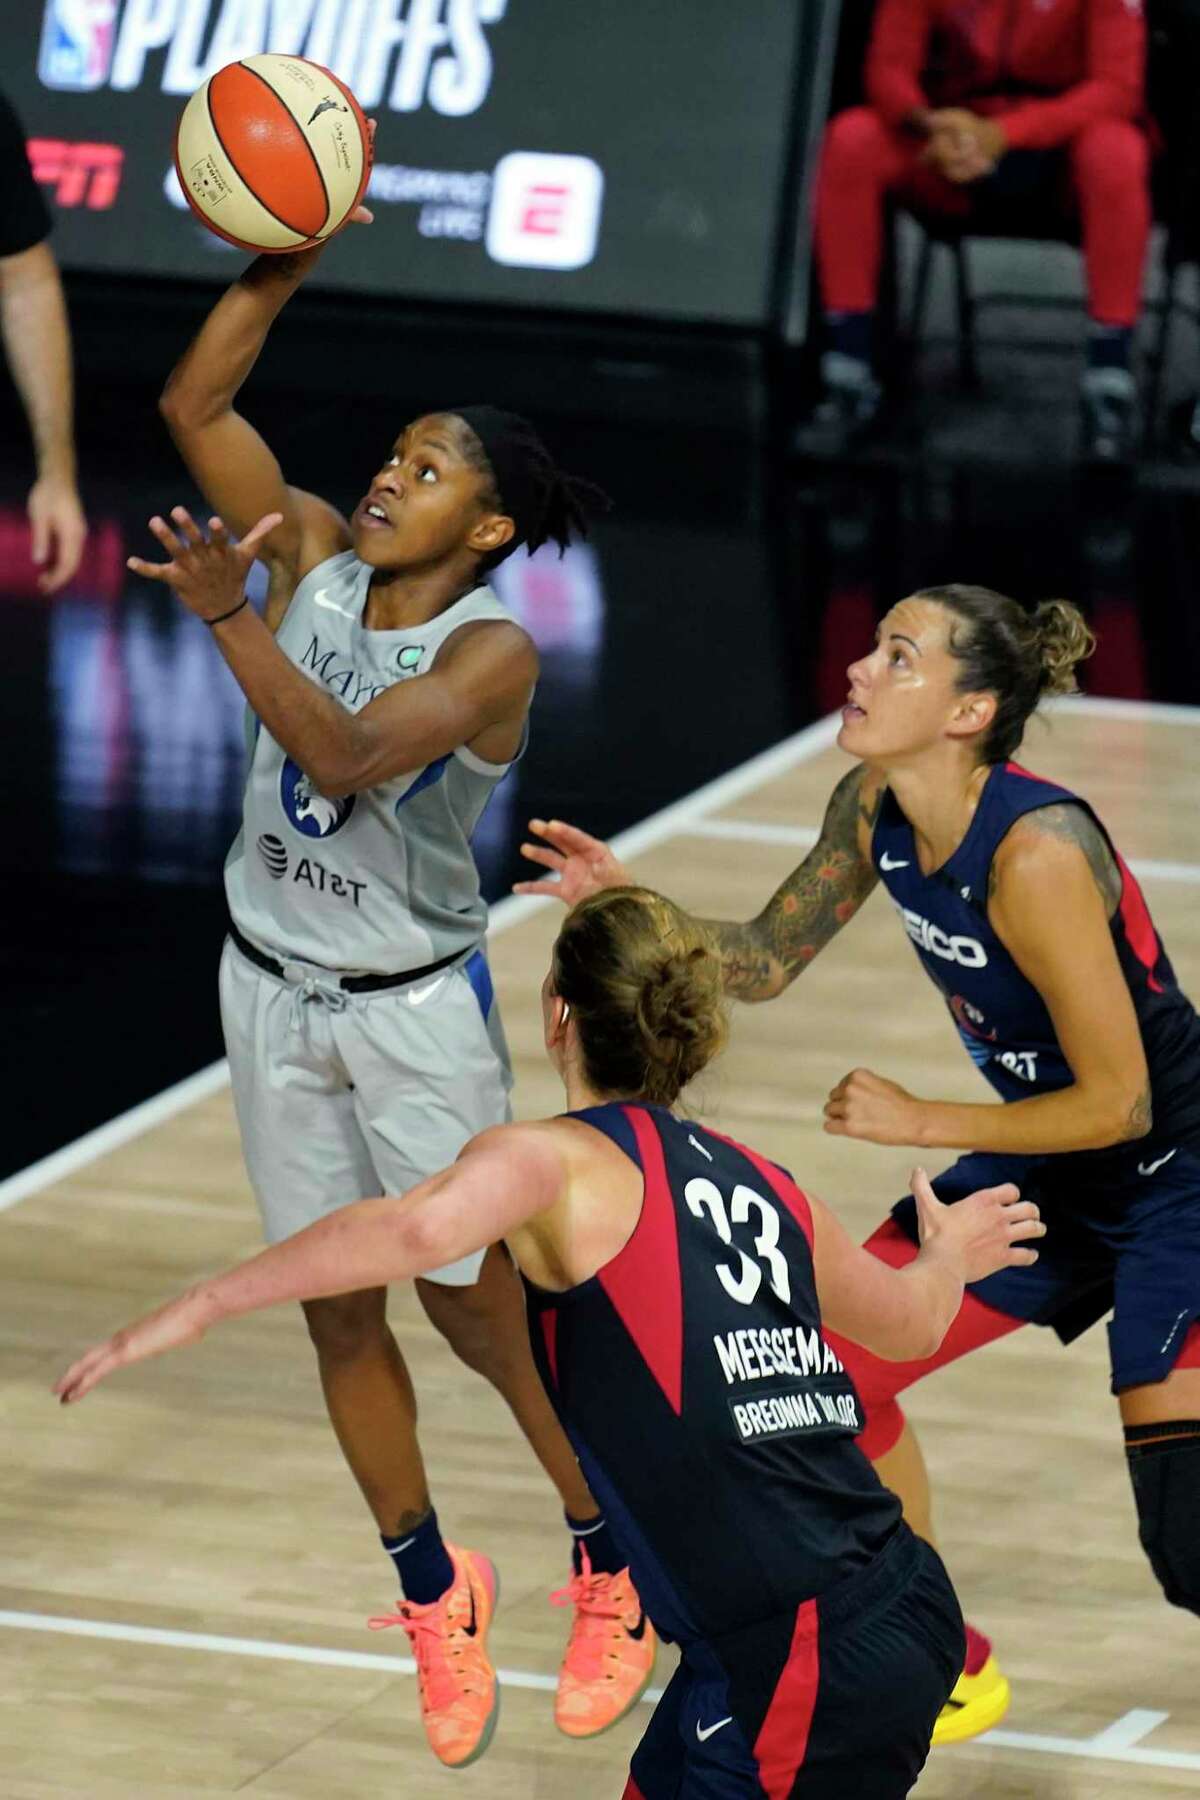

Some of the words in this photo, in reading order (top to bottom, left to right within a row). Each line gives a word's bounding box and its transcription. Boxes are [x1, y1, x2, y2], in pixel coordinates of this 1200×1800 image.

[901, 908, 988, 969] EICO
[684, 1177, 791, 1306] 33
[713, 1326, 844, 1385] MEESSEMA
[733, 1392, 822, 1438] BREONNA
